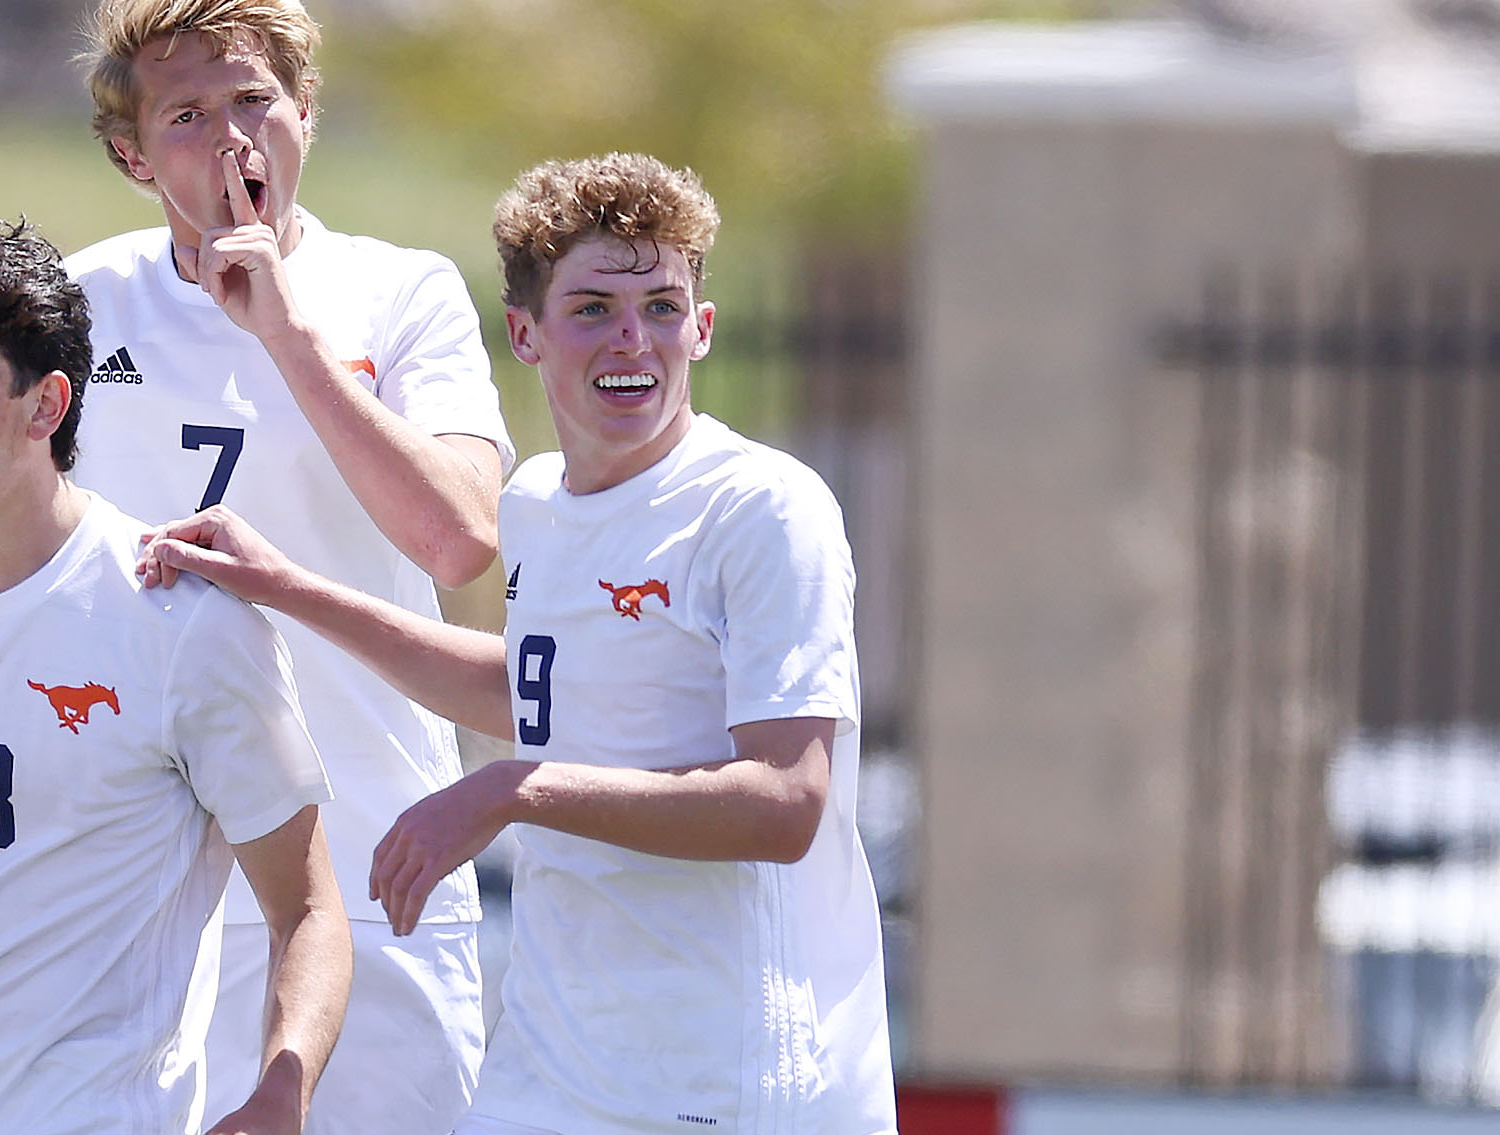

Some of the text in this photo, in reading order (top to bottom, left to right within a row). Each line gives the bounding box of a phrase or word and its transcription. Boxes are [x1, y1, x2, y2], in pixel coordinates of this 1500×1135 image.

[91, 370, 143, 385] adidas
[181, 423, 245, 514] 7
[517, 634, 556, 746] 9
